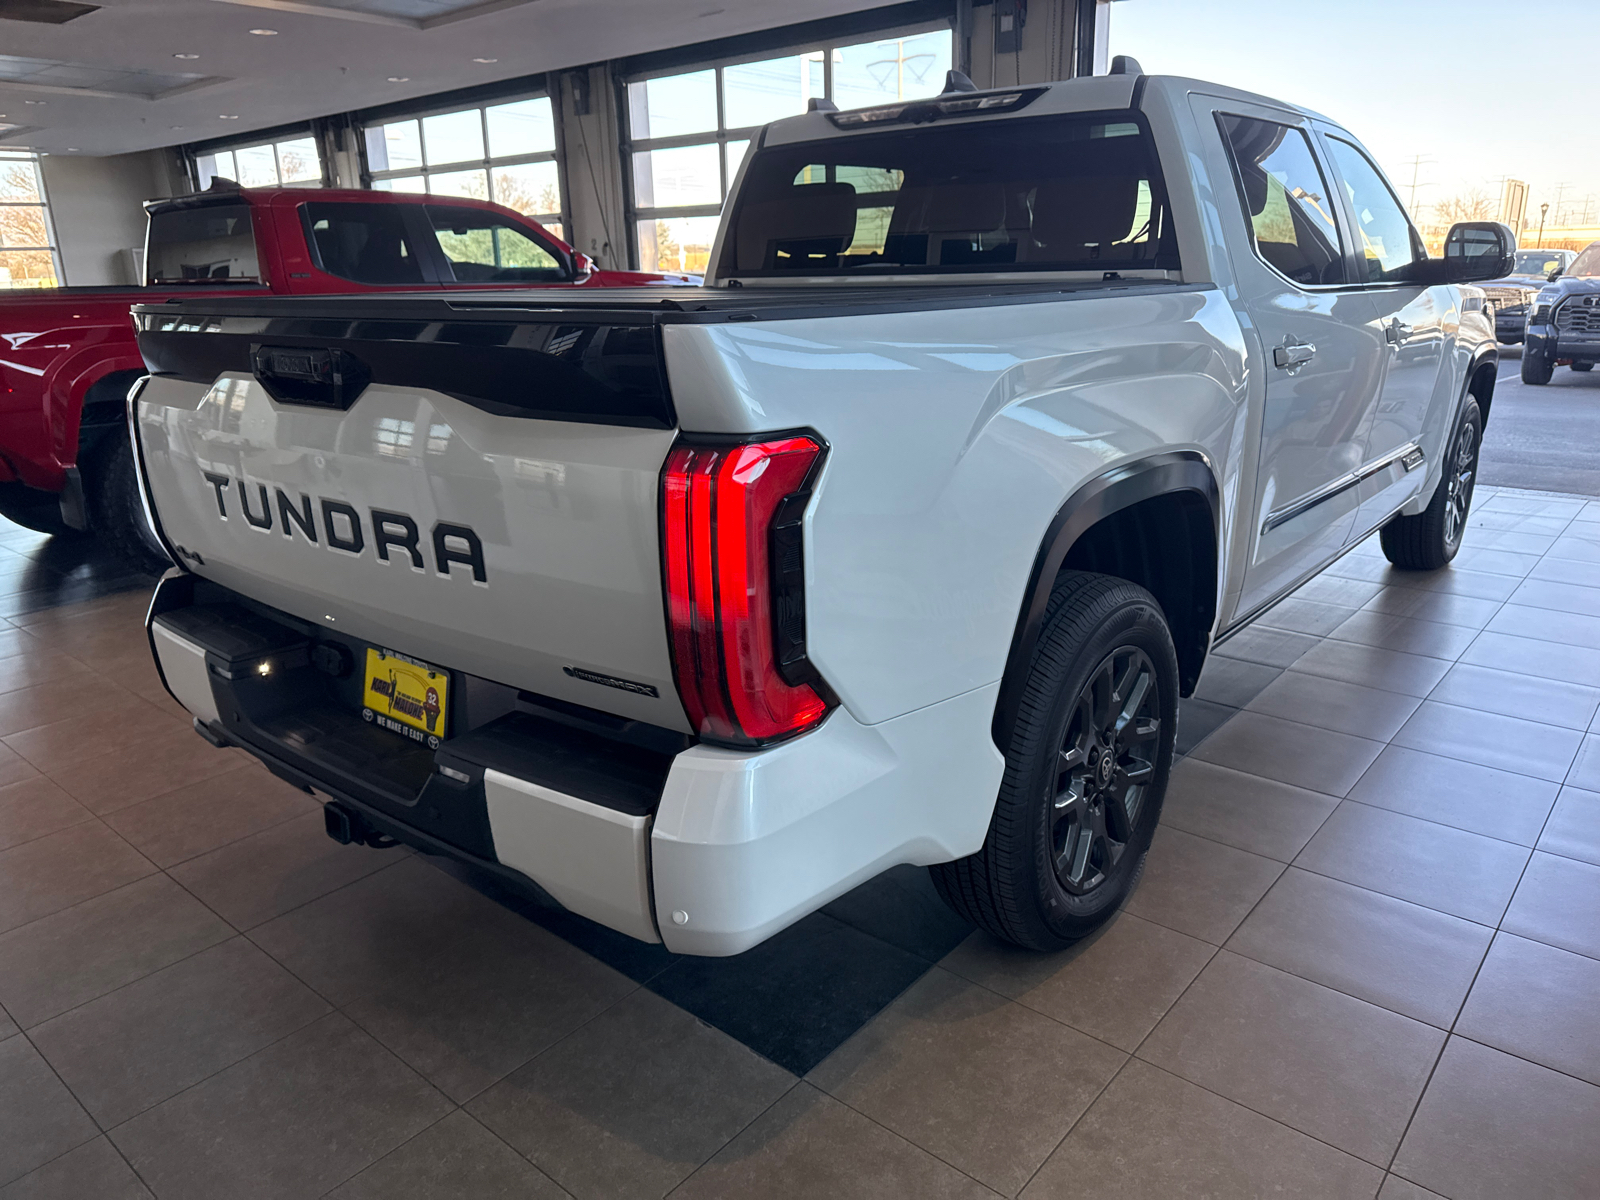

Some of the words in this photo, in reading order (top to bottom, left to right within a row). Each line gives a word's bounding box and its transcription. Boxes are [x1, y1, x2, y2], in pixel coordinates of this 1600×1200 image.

[204, 473, 488, 586] TUNDRA
[371, 676, 391, 698] KARL
[427, 692, 437, 706] 32
[393, 695, 423, 721] MALONE
[377, 715, 386, 726] WE
[386, 718, 402, 734] MAKE
[402, 725, 409, 736] IT
[409, 727, 424, 742] EASY
